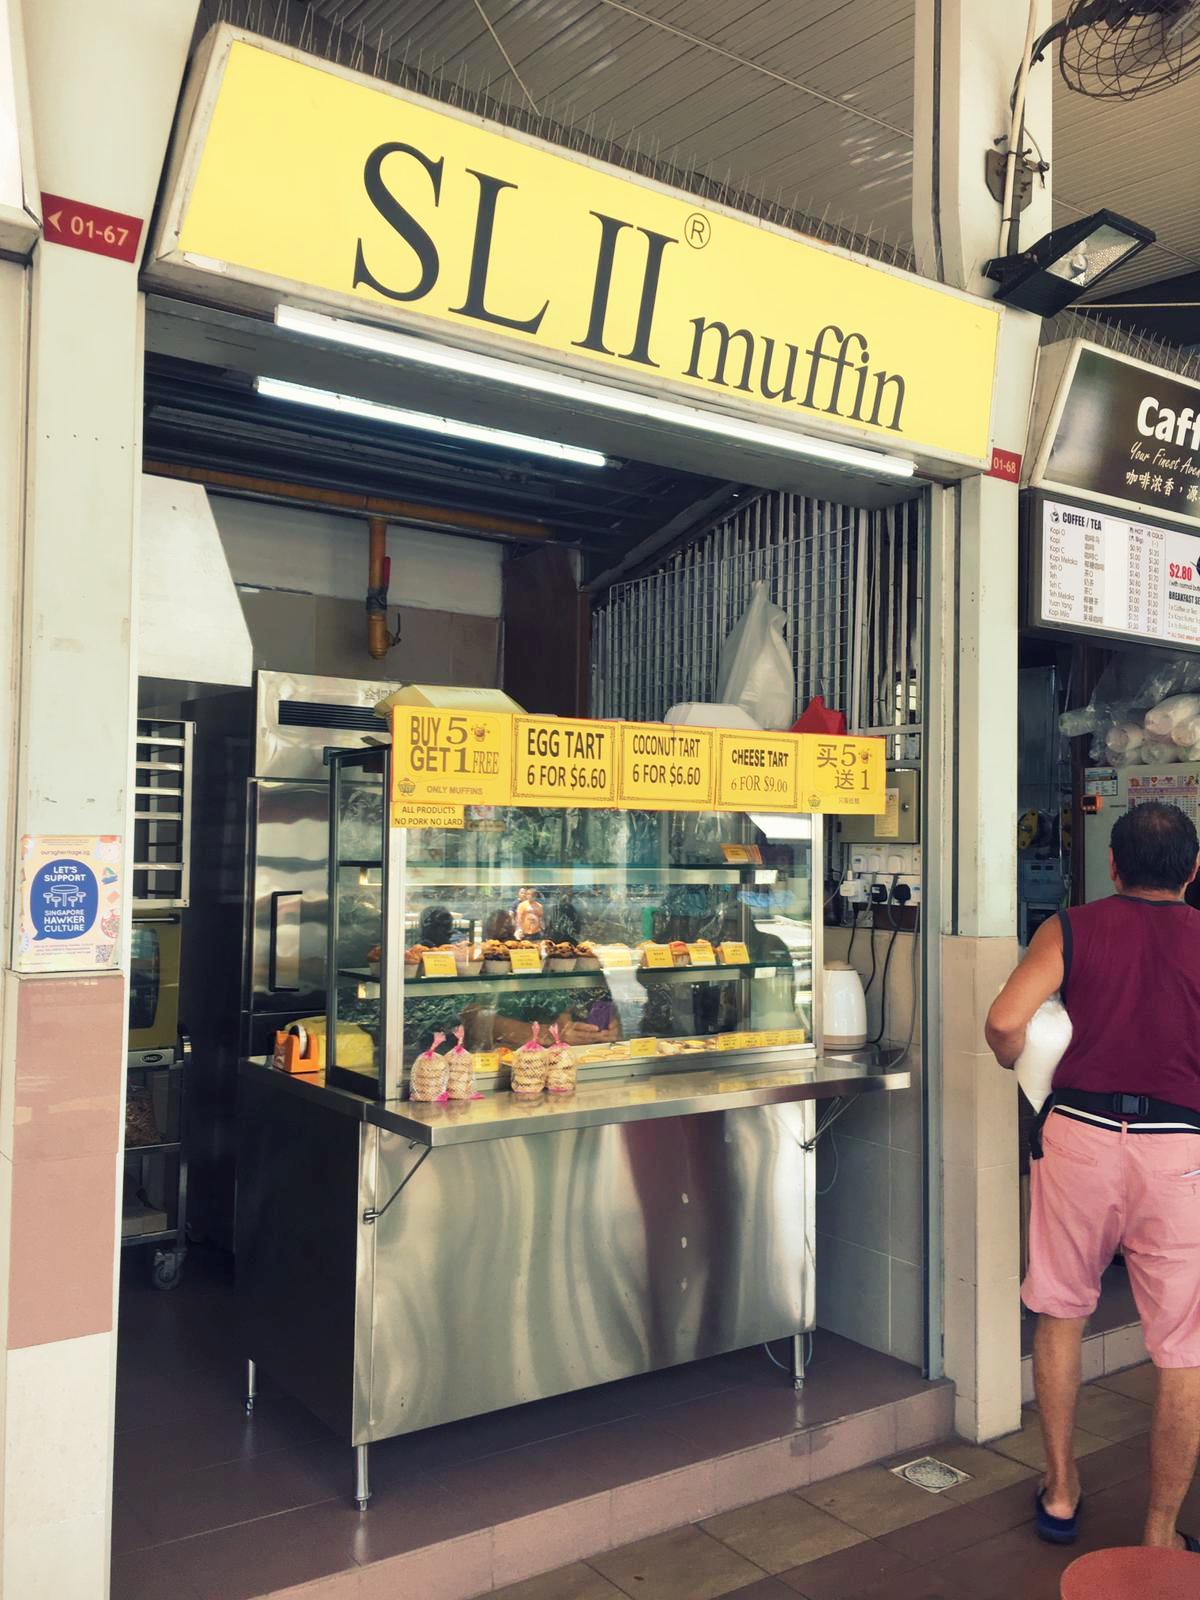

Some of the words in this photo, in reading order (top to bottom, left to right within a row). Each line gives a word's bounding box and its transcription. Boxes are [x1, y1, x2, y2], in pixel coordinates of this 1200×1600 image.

[70, 216, 129, 246] 01-67
[682, 316, 907, 432] muffin
[1130, 441, 1150, 462] Your
[1152, 448, 1180, 470] Finest
[993, 457, 1016, 474] 01-68
[1049, 527, 1060, 535] Kopi
[1062, 512, 1085, 527] COFFEE
[1090, 518, 1102, 531] TEA
[1169, 562, 1192, 581] $2.80
[1168, 590, 1194, 604] BREAKFAST
[411, 716, 441, 747] BUY
[446, 717, 468, 745] 5
[527, 728, 560, 757] EGG
[565, 731, 605, 760] TART
[632, 734, 676, 757] COCONUT
[677, 737, 700, 758] TART
[410, 745, 450, 772] GET
[454, 747, 471, 773] 1
[472, 750, 499, 774] FREE
[731, 749, 765, 767] CHEESE
[767, 751, 789, 768] TART
[527, 764, 535, 786] 6
[539, 765, 566, 787] FOR
[570, 763, 606, 791] $6.60
[632, 764, 640, 783] 6
[643, 765, 667, 784] FOR
[669, 763, 701, 787] $6.60
[731, 778, 738, 791] 6
[739, 776, 761, 792] FOR
[763, 775, 788, 793] $9.00
[426, 785, 447, 795] ONLY
[449, 786, 483, 795] MUFFINS
[402, 806, 415, 814] ALL
[416, 806, 456, 814] PRODUCTS
[394, 818, 407, 826] NO
[408, 818, 428, 826] PORK
[430, 818, 442, 826] NO
[443, 818, 463, 826] LARD
[44, 874, 86, 882] SUPPORT
[53, 866, 78, 874] LET'S
[44, 915, 85, 925] HAWKER
[44, 924, 84, 932] CULTURE
